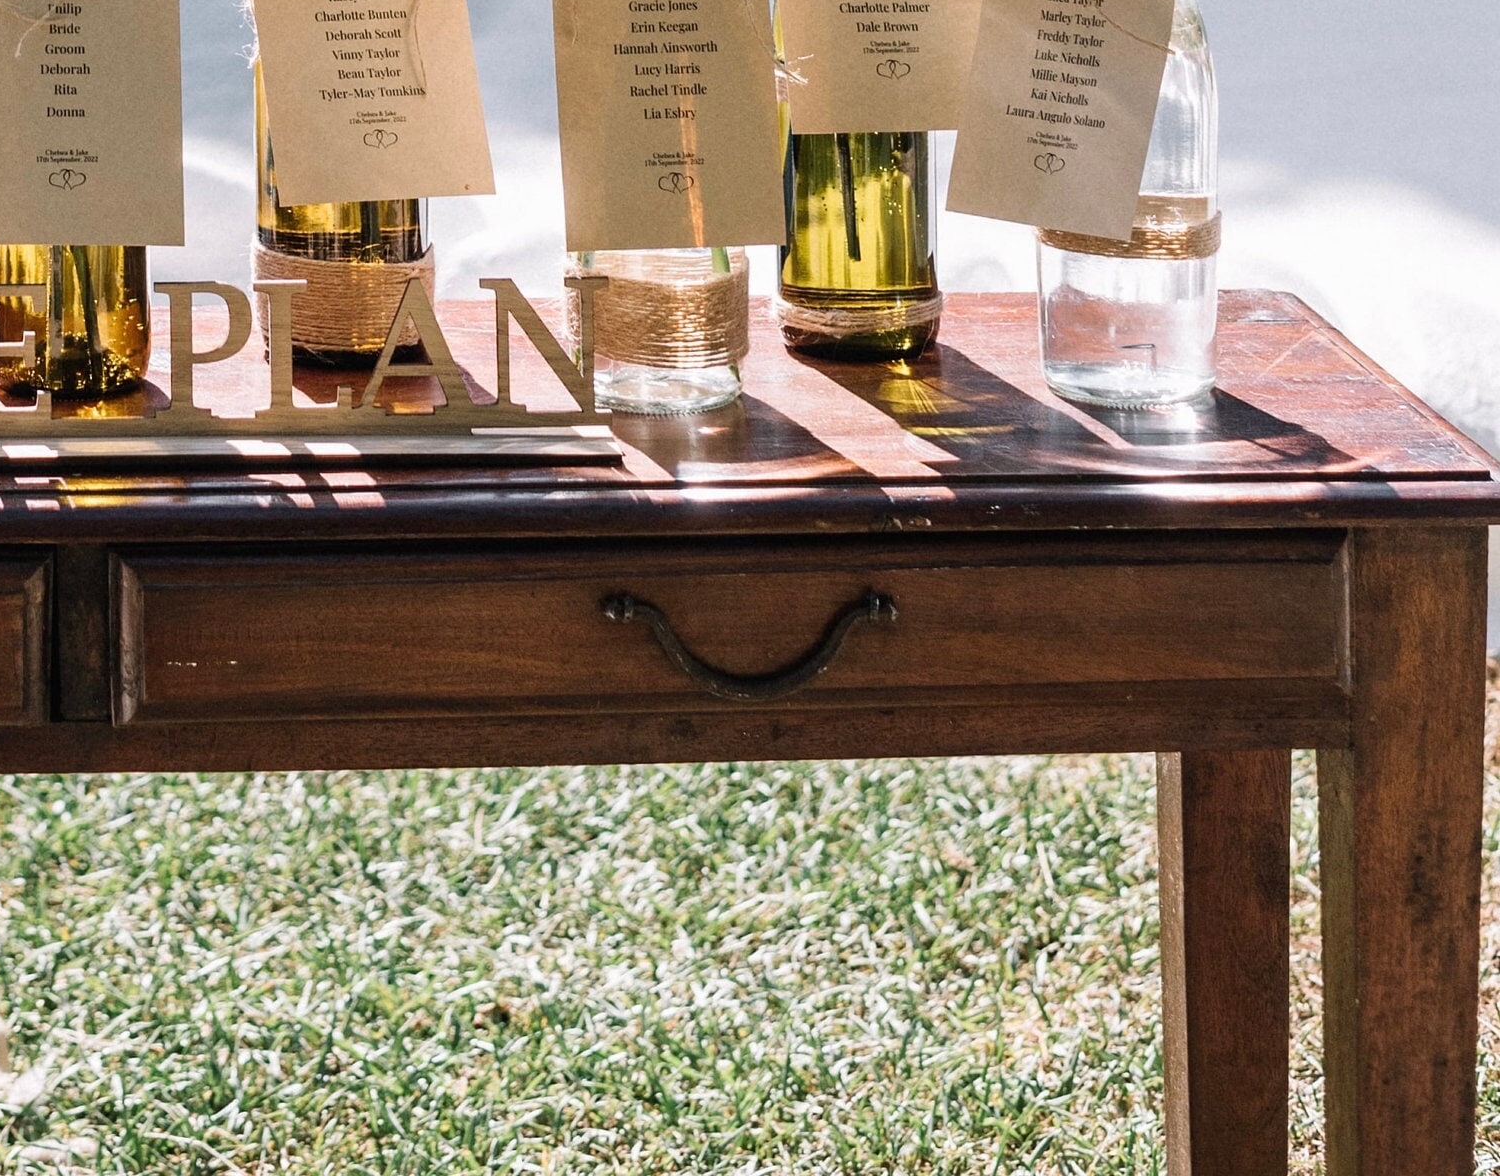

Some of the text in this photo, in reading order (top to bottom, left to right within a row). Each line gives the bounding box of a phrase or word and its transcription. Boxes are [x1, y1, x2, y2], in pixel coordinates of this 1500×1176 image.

[629, 0, 698, 12] Gracie Jones
[839, 1, 930, 13] Charlotte Palmer
[315, 9, 407, 22] Charlotte Bunten
[1040, 10, 1073, 25] Marley
[49, 23, 80, 34] Bride
[631, 22, 698, 33] Erin Keegan
[857, 21, 919, 33] Dale Brown
[326, 29, 401, 41] Deborah Scott
[1037, 29, 1105, 48] Freddy Taylor
[45, 44, 85, 54] Groom
[614, 41, 717, 55] Hannah Ainsworth
[332, 48, 400, 61] Vinny Taylor
[1035, 49, 1100, 67] Luke Nicholls
[40, 64, 90, 75] Deborah
[338, 67, 401, 79] Beau Taylor
[635, 63, 700, 77] Lucy Harris
[1030, 68, 1097, 87] Millie Mayson
[54, 84, 77, 95] Rita
[378, 85, 425, 97] Tomkins
[630, 83, 707, 97] Rachel Tindle
[1031, 88, 1089, 106] Kai Nicholls
[47, 107, 85, 117] Donna
[644, 108, 661, 119] Lia
[1006, 104, 1105, 128] Laura Angulo Solano
[153, 277, 612, 418] PLAN
